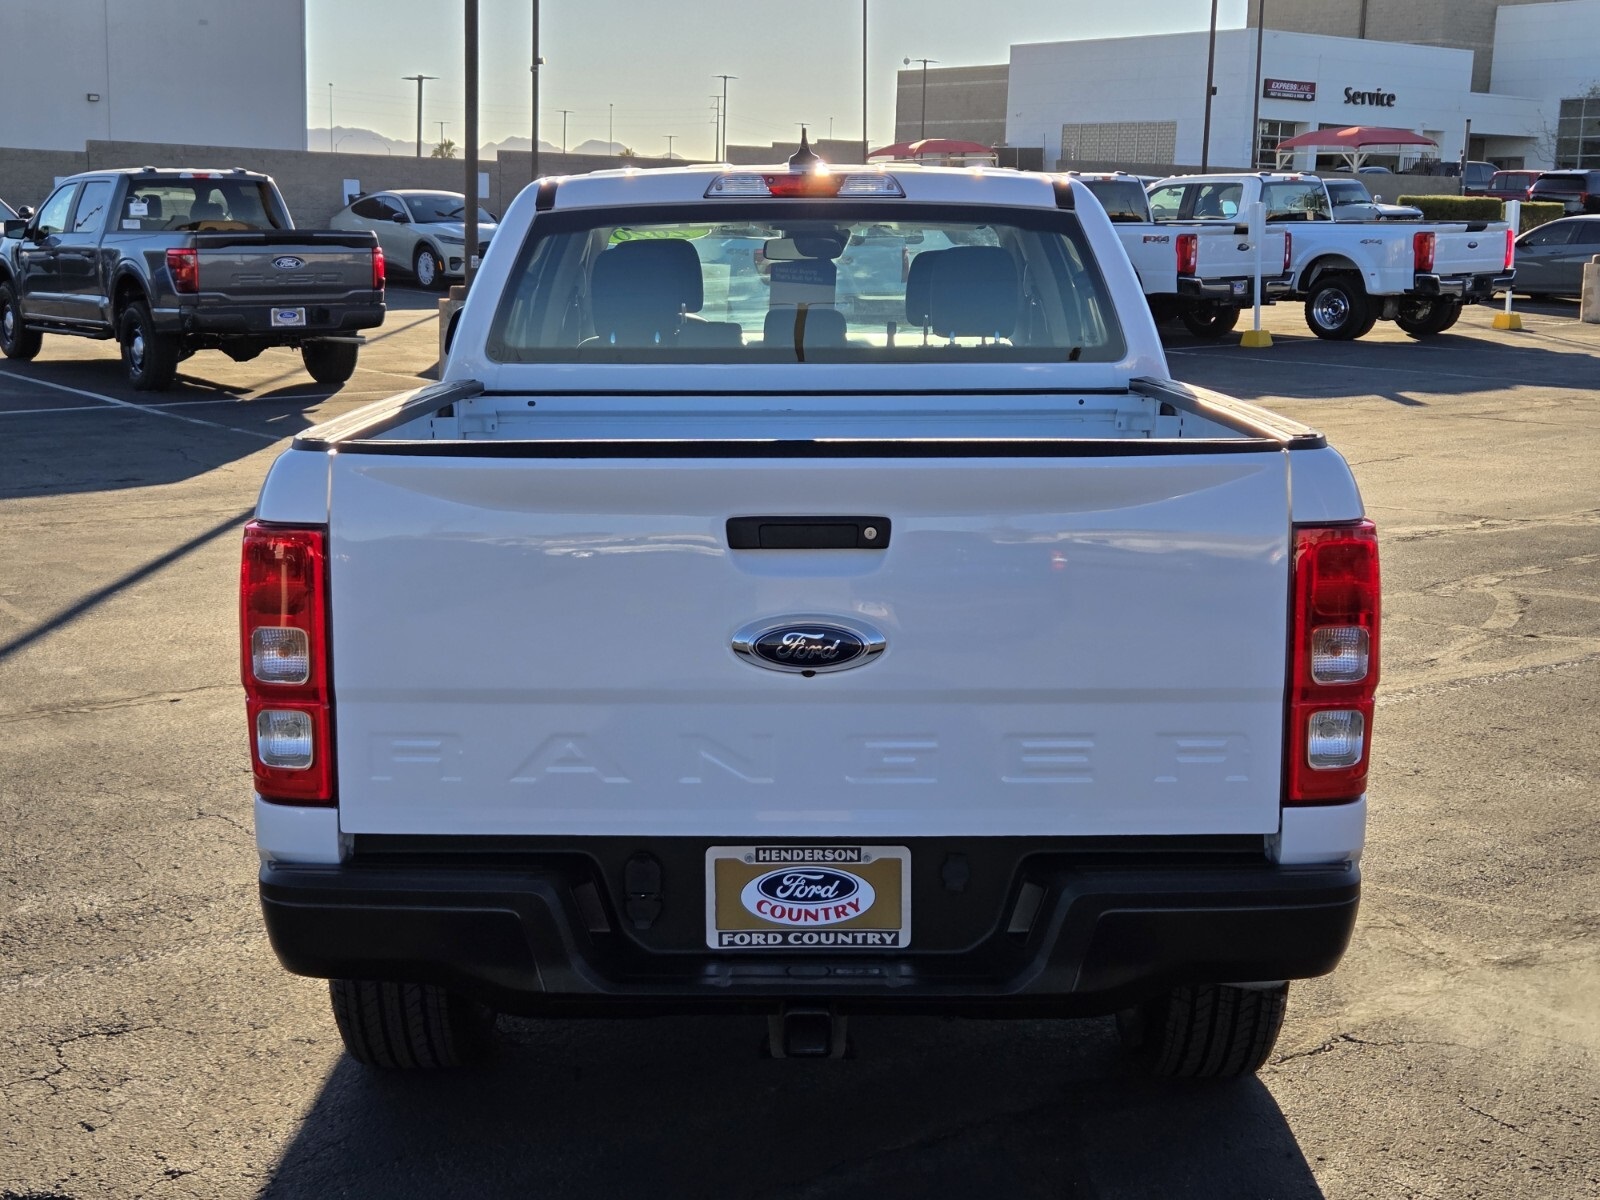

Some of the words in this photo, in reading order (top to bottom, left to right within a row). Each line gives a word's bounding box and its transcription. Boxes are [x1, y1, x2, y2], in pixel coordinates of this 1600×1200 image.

[1344, 86, 1396, 107] Service
[1143, 235, 1170, 244] FX4
[280, 258, 298, 268] Ford
[231, 272, 344, 286] F-150
[775, 632, 841, 659] Ford
[368, 732, 1250, 783] RANGER
[758, 849, 859, 862] HENDERSON
[775, 873, 841, 899] Ford
[756, 897, 861, 923] COUNTRY
[721, 932, 783, 946] FORD
[787, 932, 897, 945] COUNTRY
